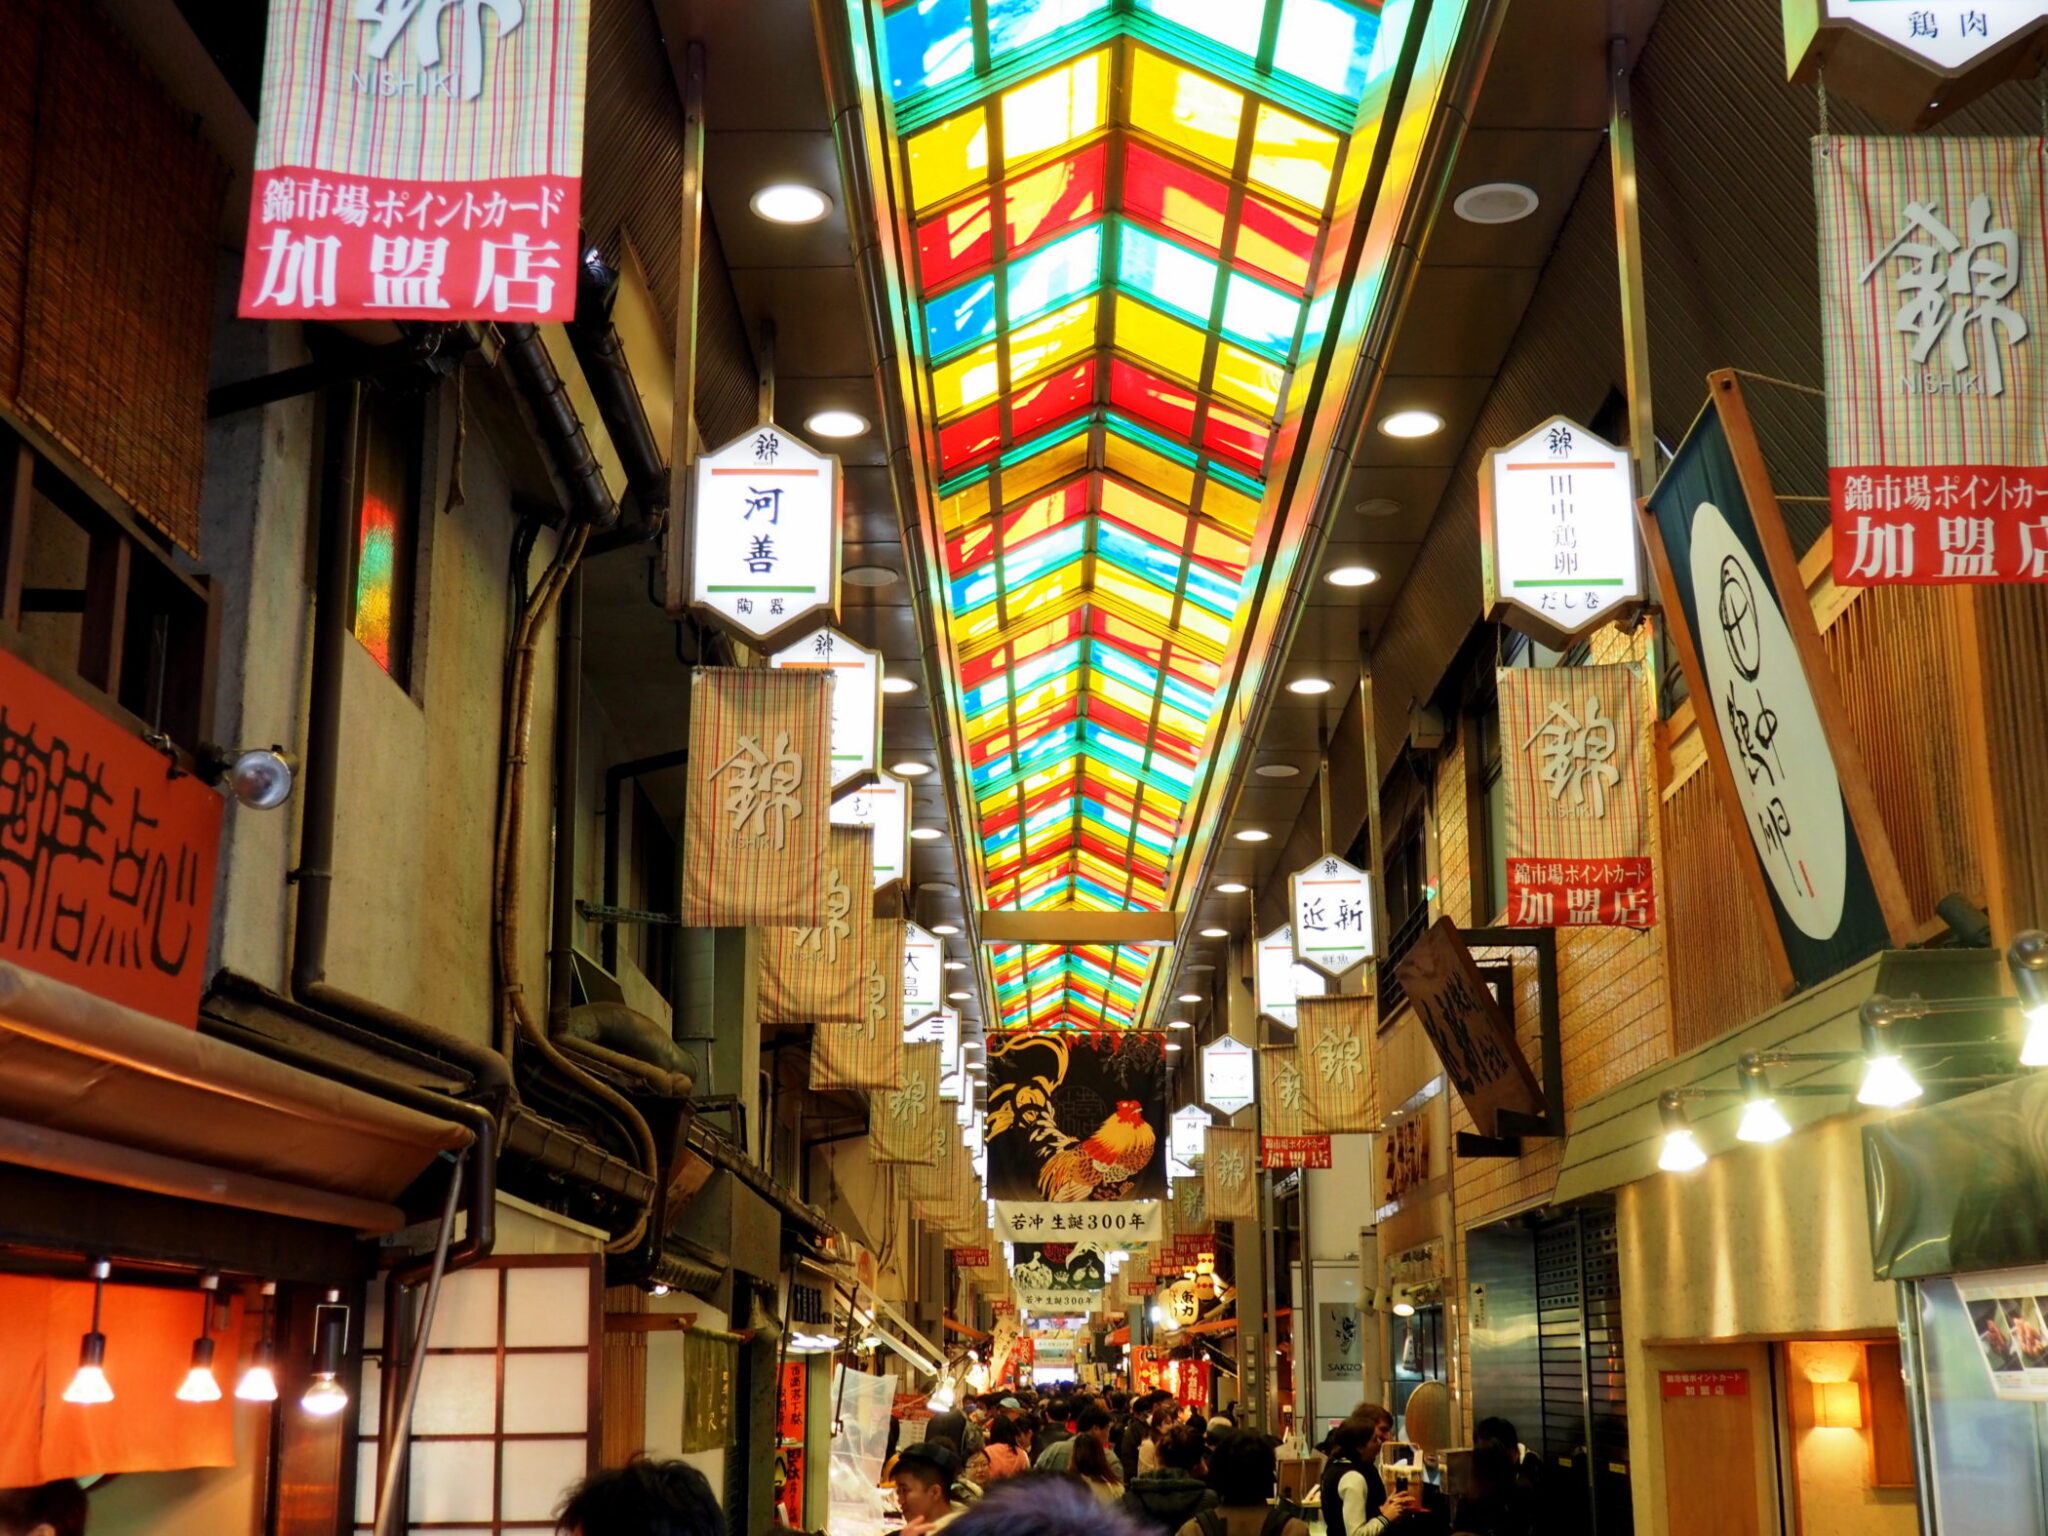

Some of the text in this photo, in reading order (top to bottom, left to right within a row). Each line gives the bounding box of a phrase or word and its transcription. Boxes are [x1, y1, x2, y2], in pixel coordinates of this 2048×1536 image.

[1908, 10, 1988, 39] 鶏肉
[262, 175, 565, 231] 錦市場ポイントカード
[252, 229, 562, 314] 加盟店
[1859, 192, 2028, 397] 錦
[743, 486, 784, 574] 河善
[737, 598, 785, 615] 陶器
[1541, 591, 1600, 610] だし巻
[1522, 696, 1620, 819] 錦
[707, 731, 802, 850] 錦
[1514, 862, 1647, 886] 錦市場ポイントカード
[1302, 897, 1364, 932] 近新
[1515, 887, 1649, 925] 加盟店
[1309, 1025, 1364, 1092] 錦
[1266, 1150, 1329, 1168] 加盟店
[1011, 1213, 1146, 1231] 若冲 生誕300年
